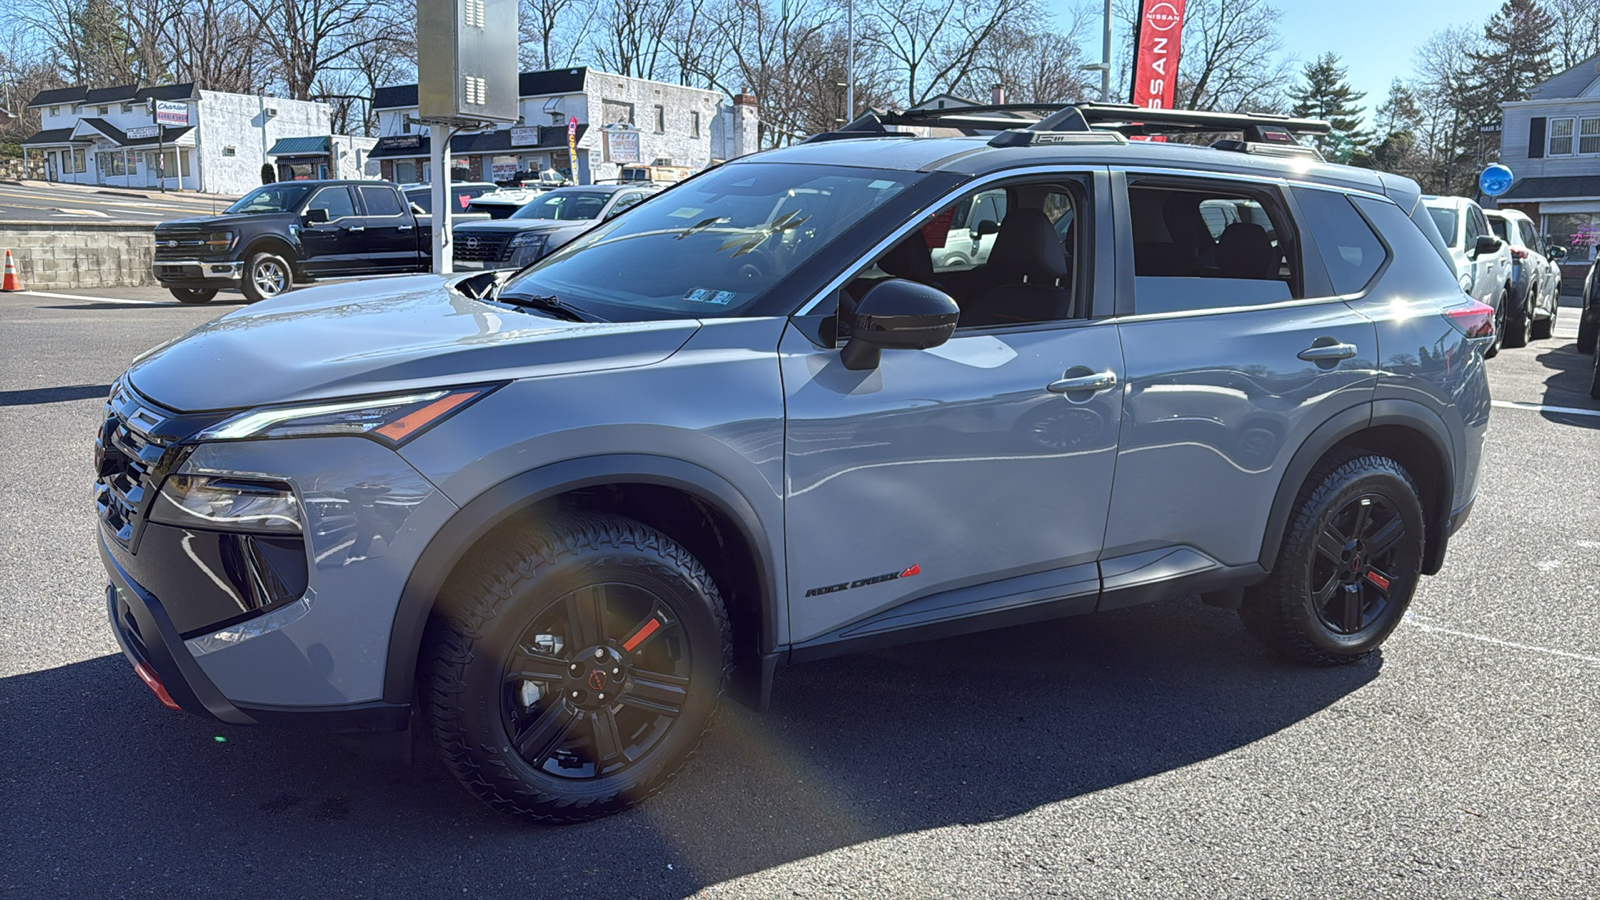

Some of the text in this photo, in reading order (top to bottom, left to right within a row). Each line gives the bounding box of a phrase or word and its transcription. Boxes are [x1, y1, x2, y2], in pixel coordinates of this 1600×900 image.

[1146, 13, 1180, 21] NISSAN
[1148, 37, 1168, 110] SSAN
[805, 571, 900, 598] ROCK CREEK
